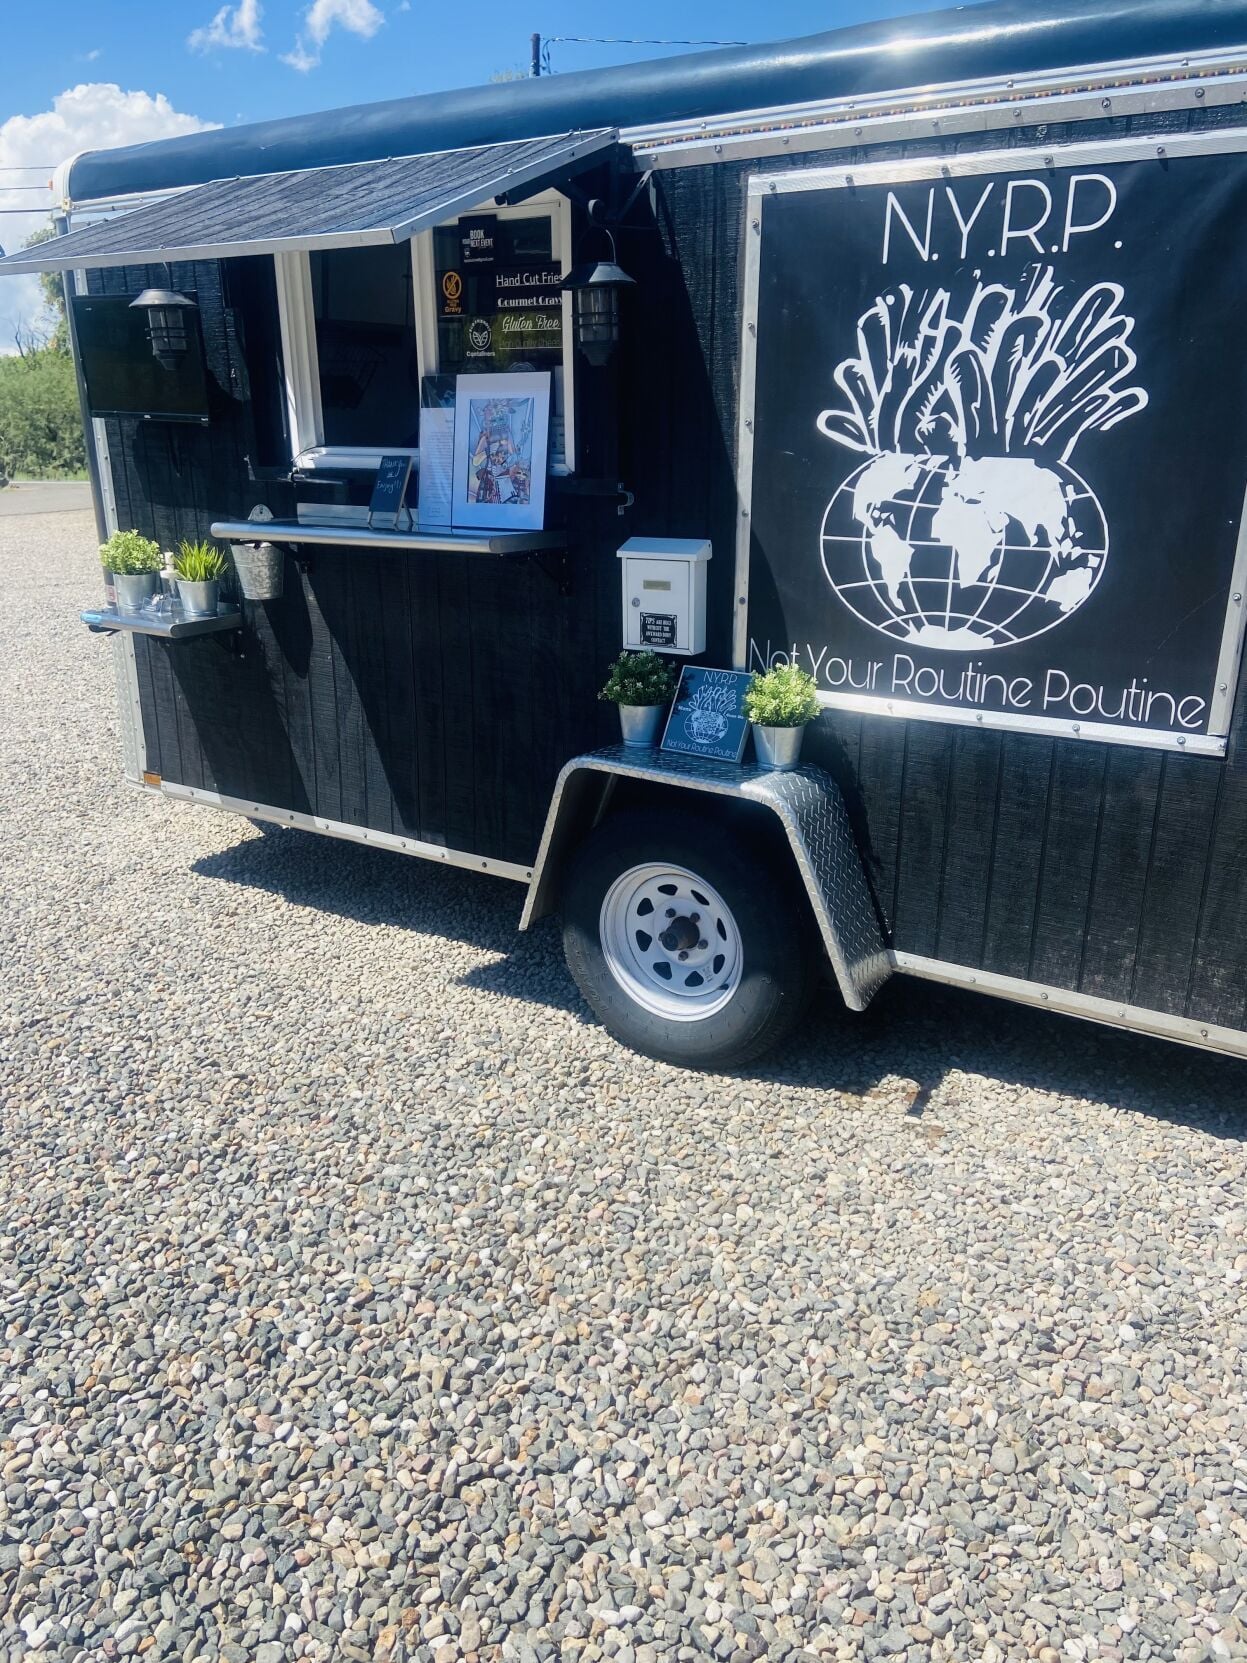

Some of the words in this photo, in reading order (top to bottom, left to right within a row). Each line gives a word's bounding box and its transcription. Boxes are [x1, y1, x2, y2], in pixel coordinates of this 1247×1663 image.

[882, 173, 1123, 265] N.Y.R.P.
[470, 229, 484, 240] BOOK
[496, 272, 520, 287] Hand
[522, 272, 540, 286] Cut
[497, 296, 537, 307] Gourmet
[502, 315, 533, 334] Gluten
[535, 314, 560, 330] Free
[806, 643, 884, 691] Your
[891, 653, 1033, 708] Routine
[1043, 669, 1206, 728] Poutine
